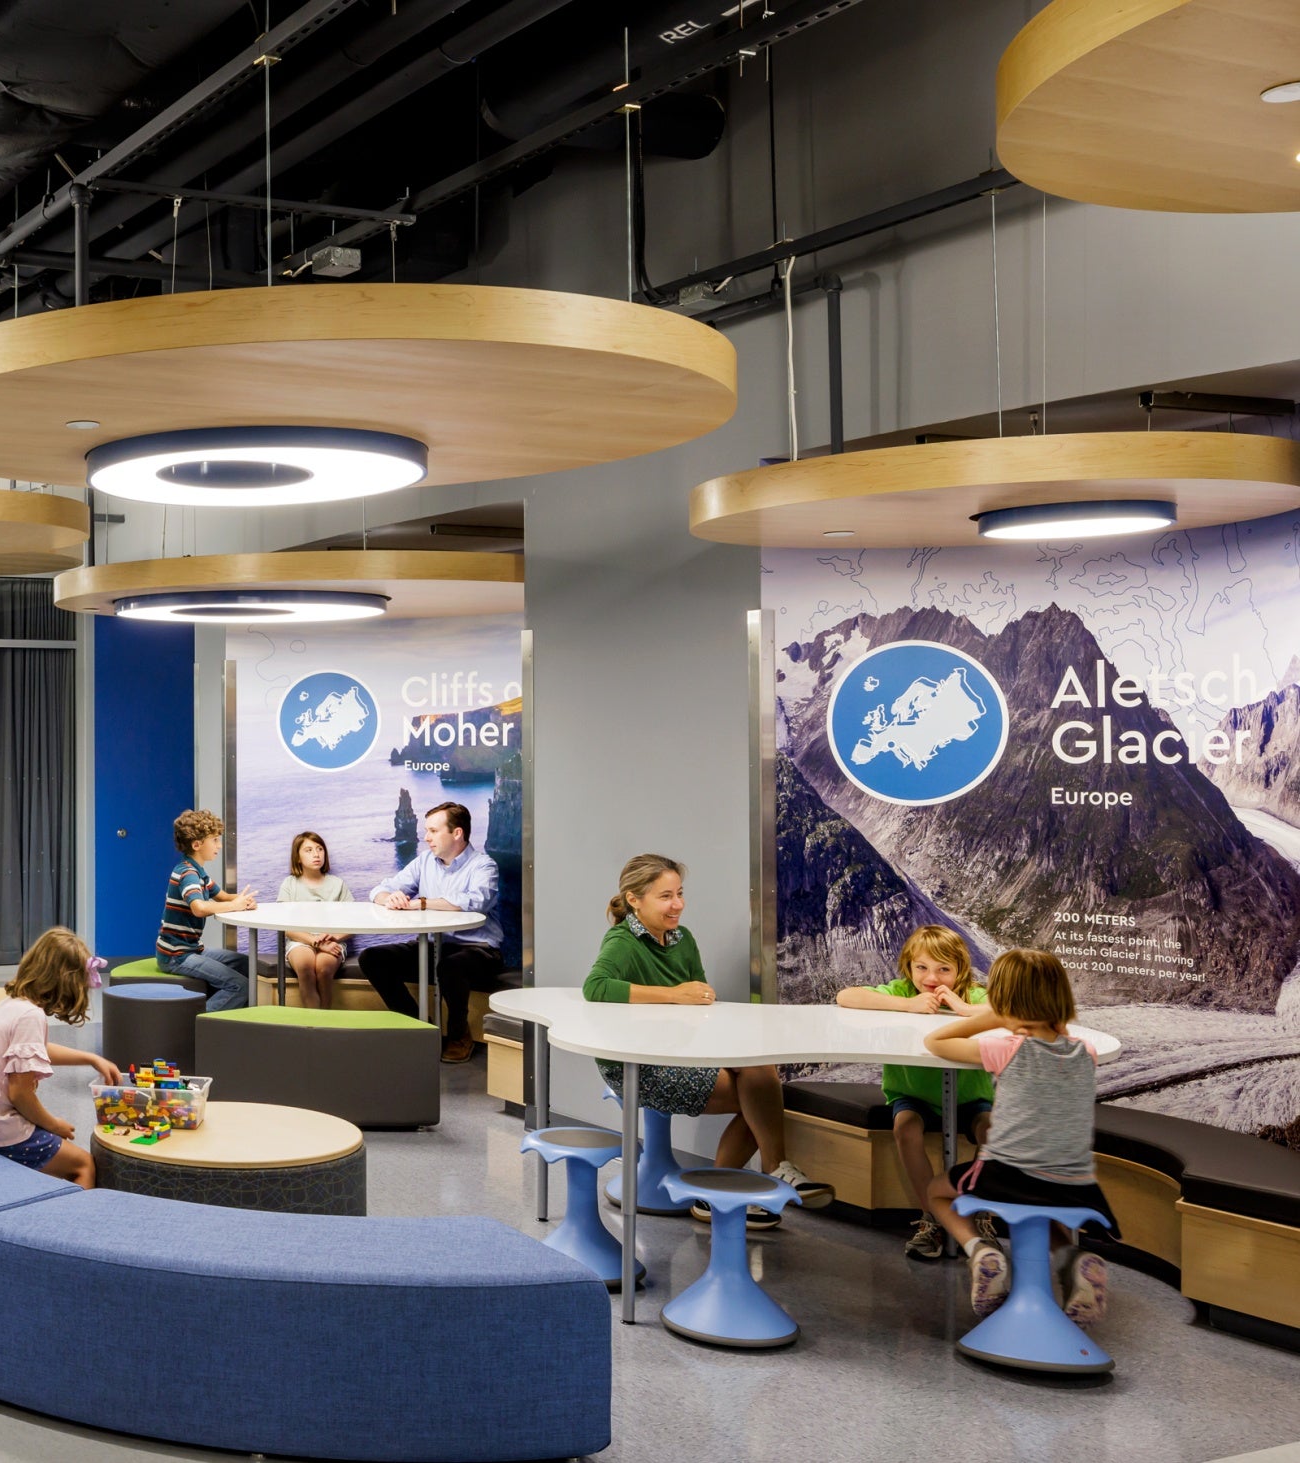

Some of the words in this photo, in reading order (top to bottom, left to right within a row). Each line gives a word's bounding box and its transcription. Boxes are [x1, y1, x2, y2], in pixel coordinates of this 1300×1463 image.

[658, 20, 712, 44] REL
[401, 670, 494, 708] Cliffs
[503, 681, 522, 701] o
[1050, 653, 1258, 709] Aletsch
[403, 711, 514, 747] Moher
[1051, 713, 1251, 765] Glacier
[404, 760, 450, 774] Europe
[1051, 787, 1133, 810] Europe
[1054, 912, 1080, 923] 200
[1084, 914, 1136, 927] METERS
[1054, 931, 1067, 940] At
[1070, 931, 1084, 941] its
[1087, 931, 1125, 945] fastest
[1128, 936, 1161, 949] point,
[1163, 938, 1182, 950] the
[1054, 944, 1097, 956] Aletsch
[1100, 948, 1140, 960] Glacier
[1143, 950, 1152, 961] is
[1154, 954, 1194, 968] moving
[1060, 958, 1089, 971] bout
[1091, 962, 1114, 973] 200
[1116, 965, 1156, 977] meters
[1158, 970, 1177, 979] per
[1179, 972, 1206, 982] year!
